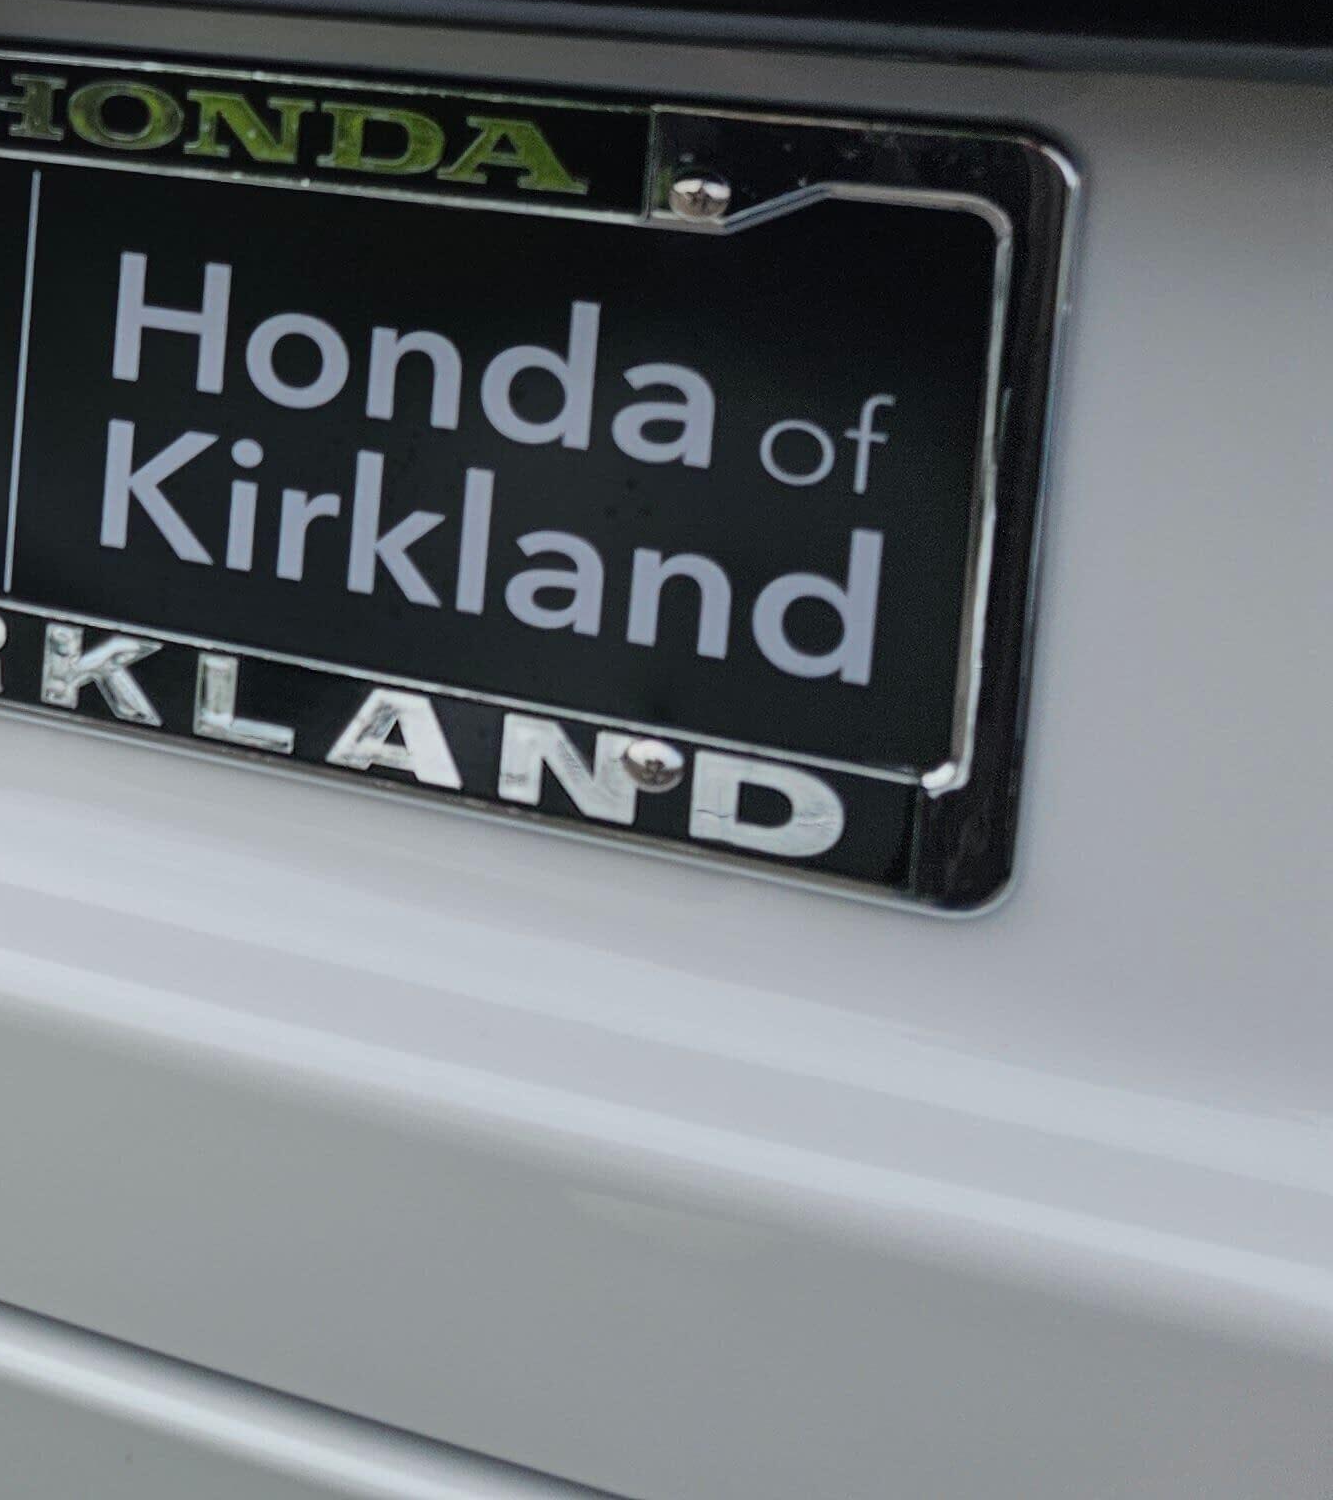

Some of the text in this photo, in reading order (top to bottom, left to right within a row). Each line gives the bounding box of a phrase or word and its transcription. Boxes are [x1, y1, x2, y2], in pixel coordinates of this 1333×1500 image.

[111, 251, 894, 494] Honda of
[99, 418, 885, 686] Kirkland
